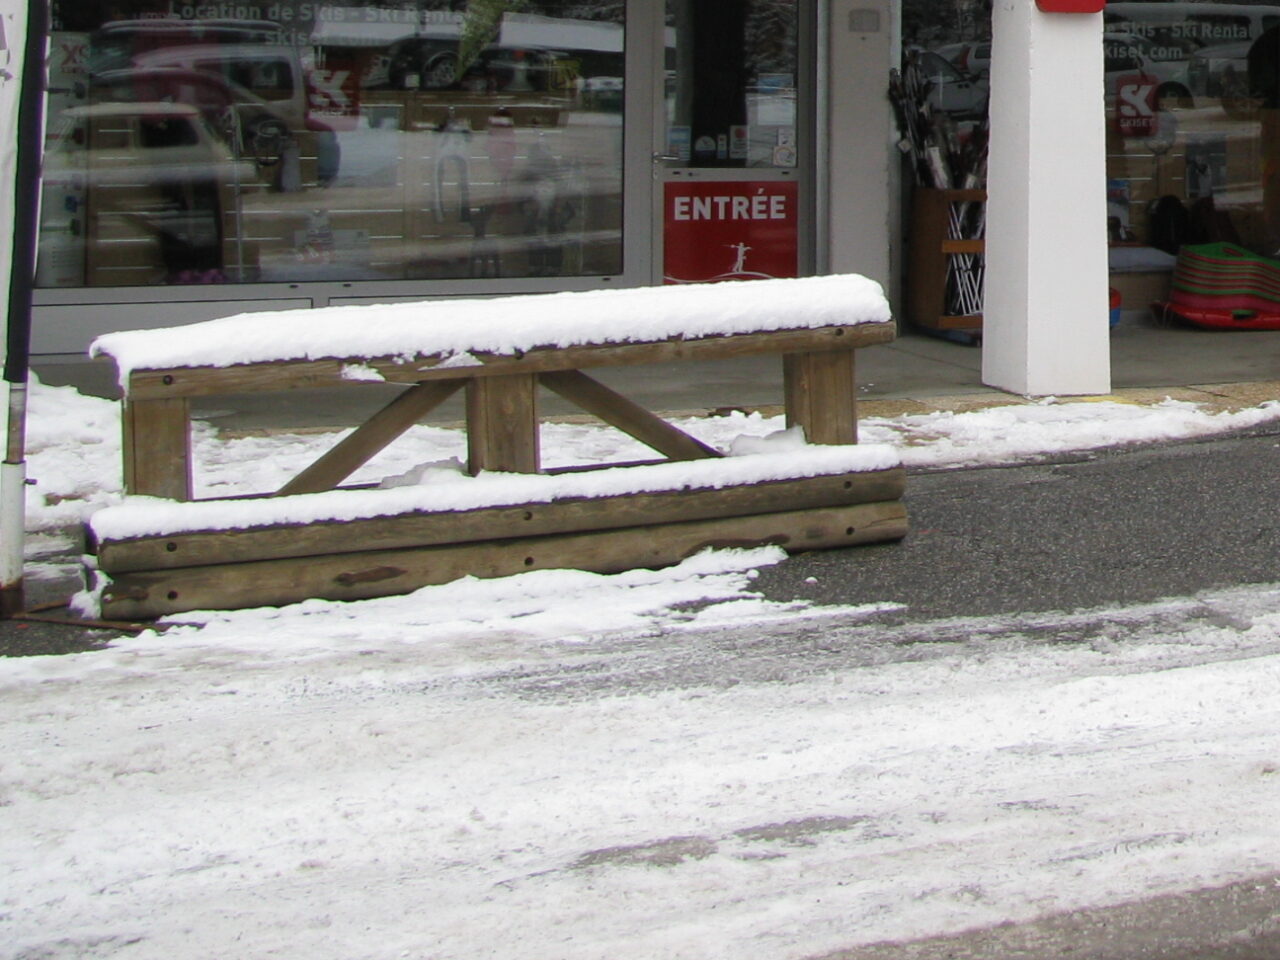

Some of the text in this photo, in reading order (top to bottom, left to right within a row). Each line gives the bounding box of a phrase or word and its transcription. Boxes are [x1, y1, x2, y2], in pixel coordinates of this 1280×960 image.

[169, 0, 262, 21] Location
[268, 3, 295, 22] de
[300, 3, 345, 23] Skis
[1171, 23, 1197, 38] Ski
[1104, 42, 1183, 59] kiset.com
[673, 187, 786, 221] ENTRÉE
